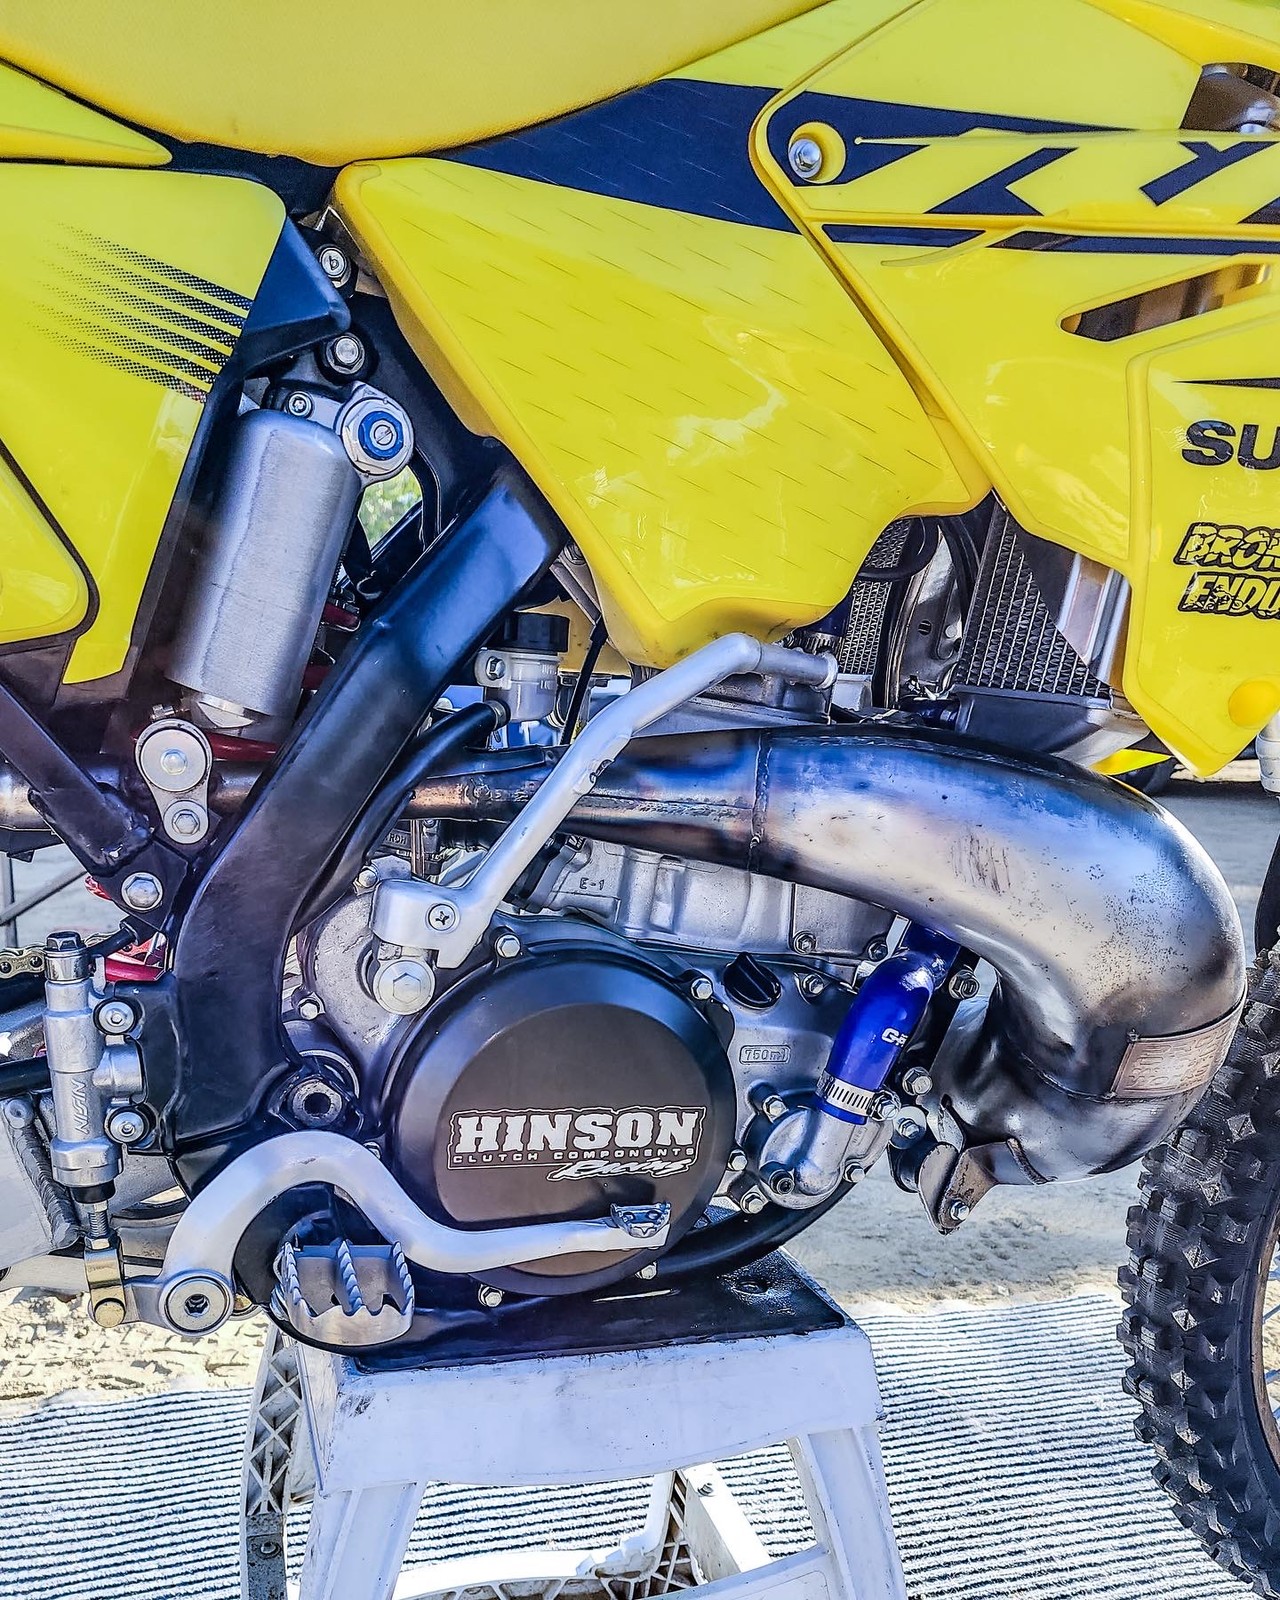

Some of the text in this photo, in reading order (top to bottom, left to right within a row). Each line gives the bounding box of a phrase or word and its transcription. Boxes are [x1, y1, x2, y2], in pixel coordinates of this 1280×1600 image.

[455, 1111, 699, 1154] HINSON
[453, 1147, 695, 1163] CLUTCH COMPONENTS
